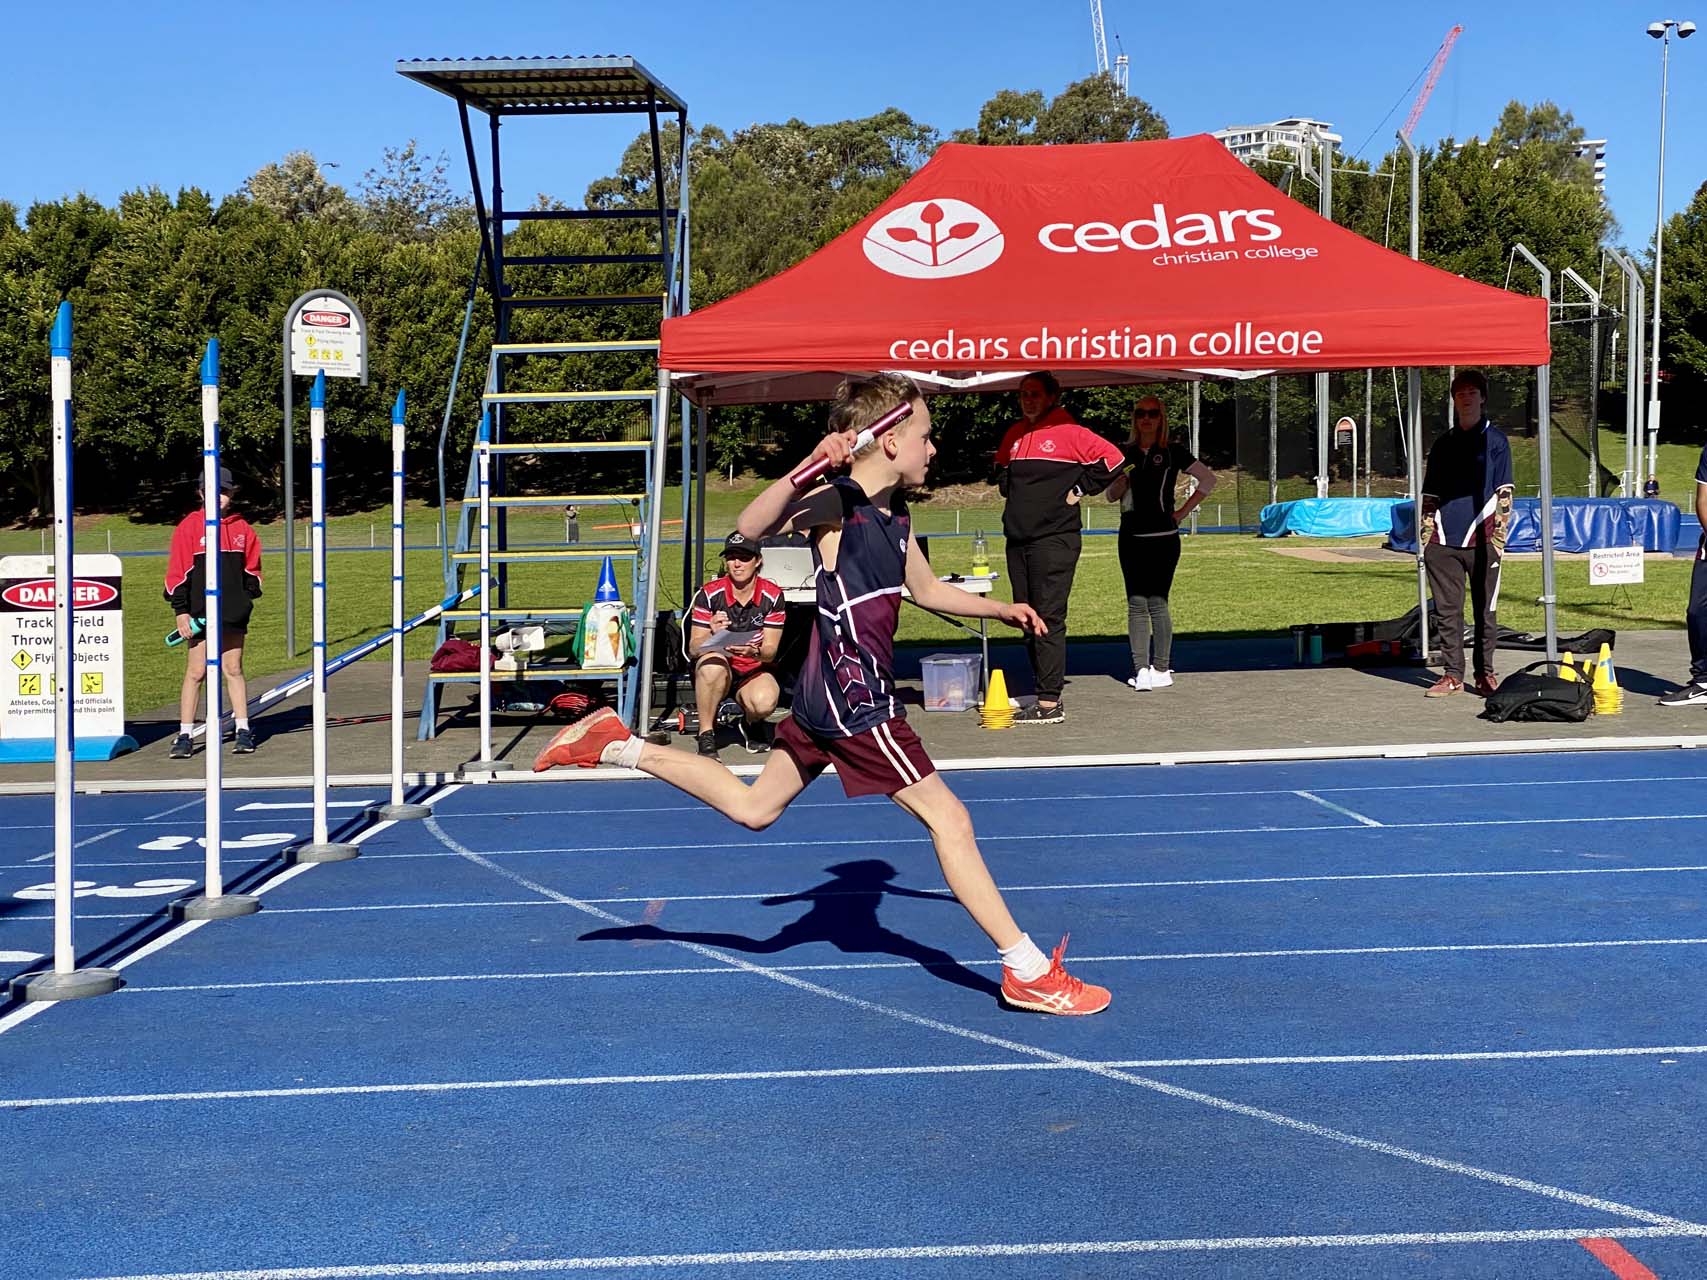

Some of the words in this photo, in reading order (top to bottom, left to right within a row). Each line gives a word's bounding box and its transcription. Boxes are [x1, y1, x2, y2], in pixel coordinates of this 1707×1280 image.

[1038, 203, 1283, 253] cedars
[1152, 248, 1239, 266] christian
[1244, 245, 1319, 260] college
[309, 314, 343, 324] DANGER
[889, 329, 1009, 360] cedars
[1019, 327, 1177, 360] christian
[1189, 321, 1324, 356] college
[1593, 552, 1624, 560] Restricted
[19, 586, 100, 603] DAER
[16, 617, 54, 628] Track
[78, 633, 109, 644] Area
[98, 706, 115, 714] point
